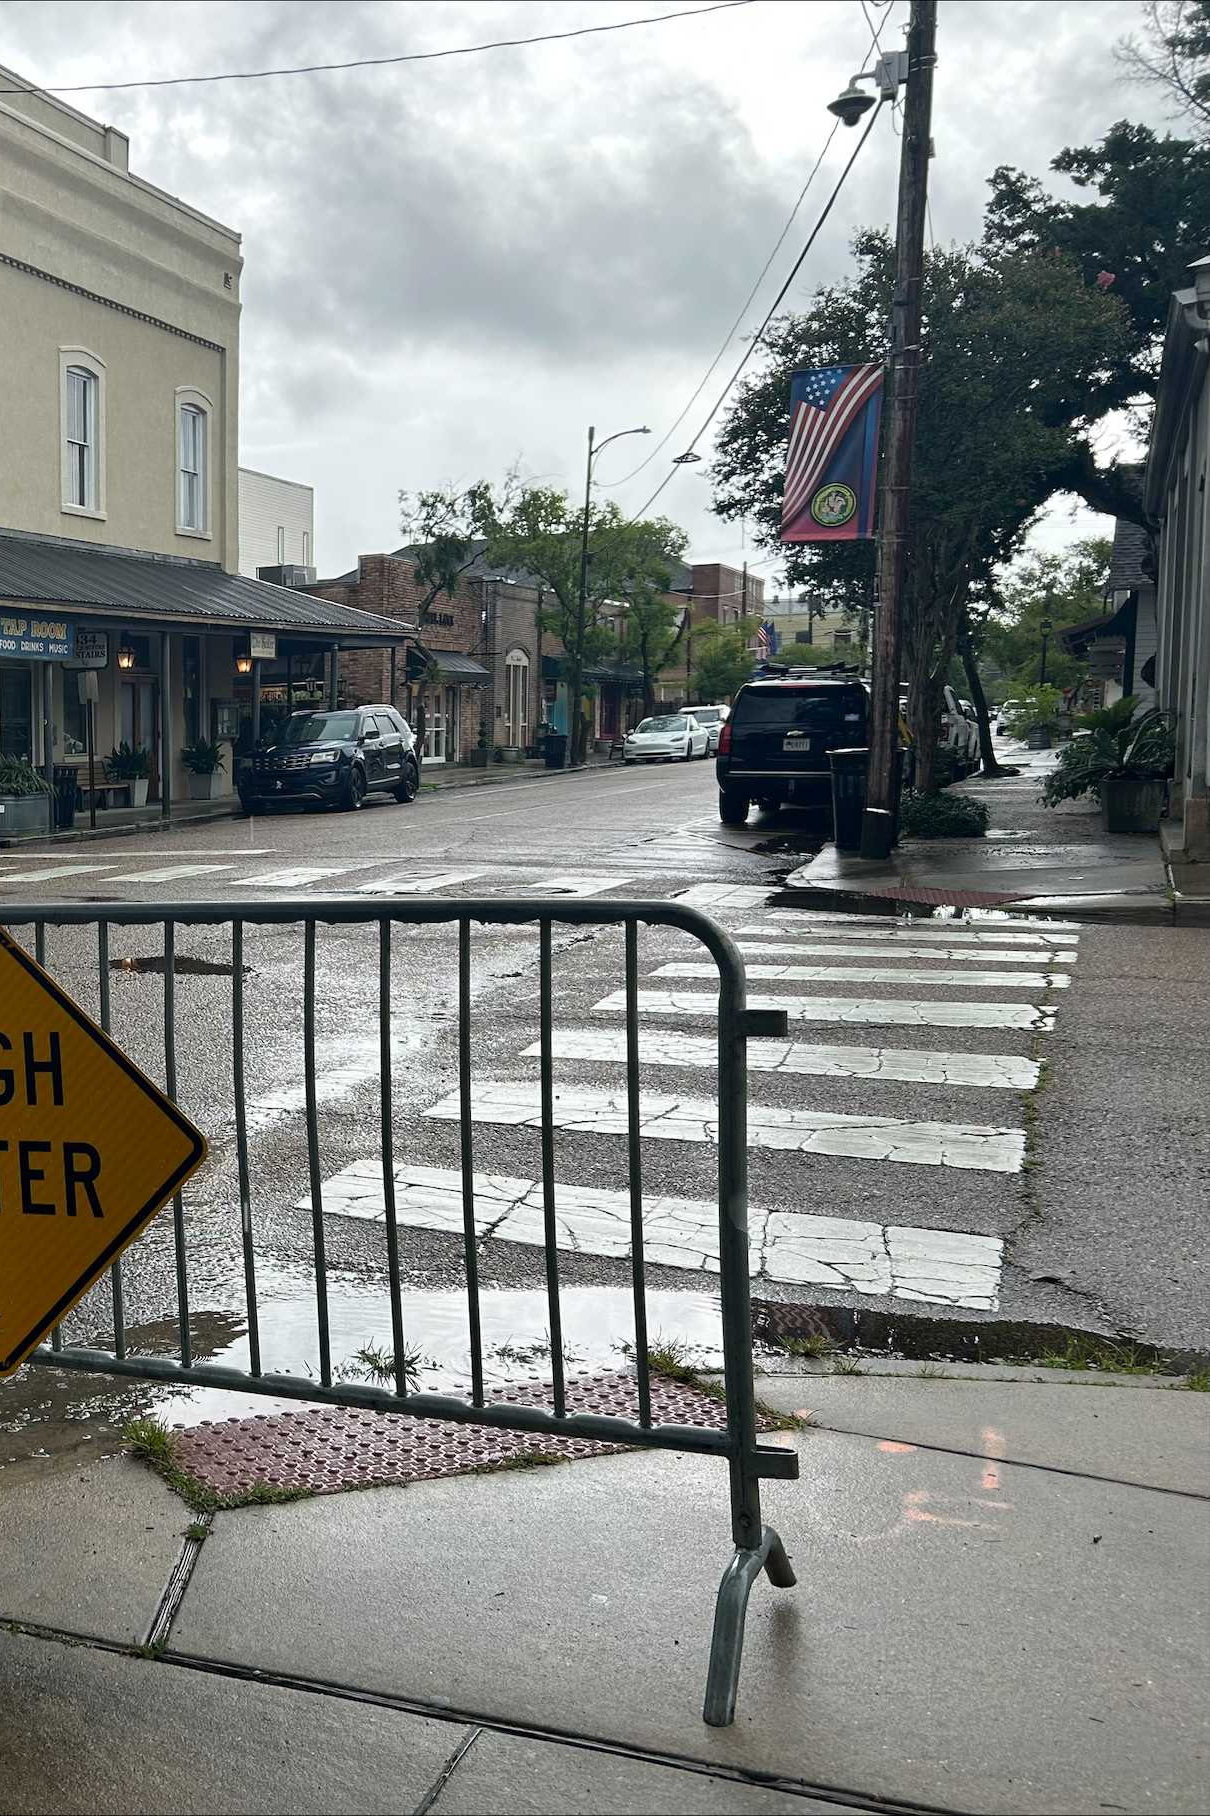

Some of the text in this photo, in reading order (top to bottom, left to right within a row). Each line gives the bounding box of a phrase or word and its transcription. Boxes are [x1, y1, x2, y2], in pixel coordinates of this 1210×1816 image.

[0, 618, 67, 640] TAP ROOM
[0, 639, 16, 650] FOOD
[21, 640, 44, 652] DRINKS
[49, 643, 68, 654] MUSIC
